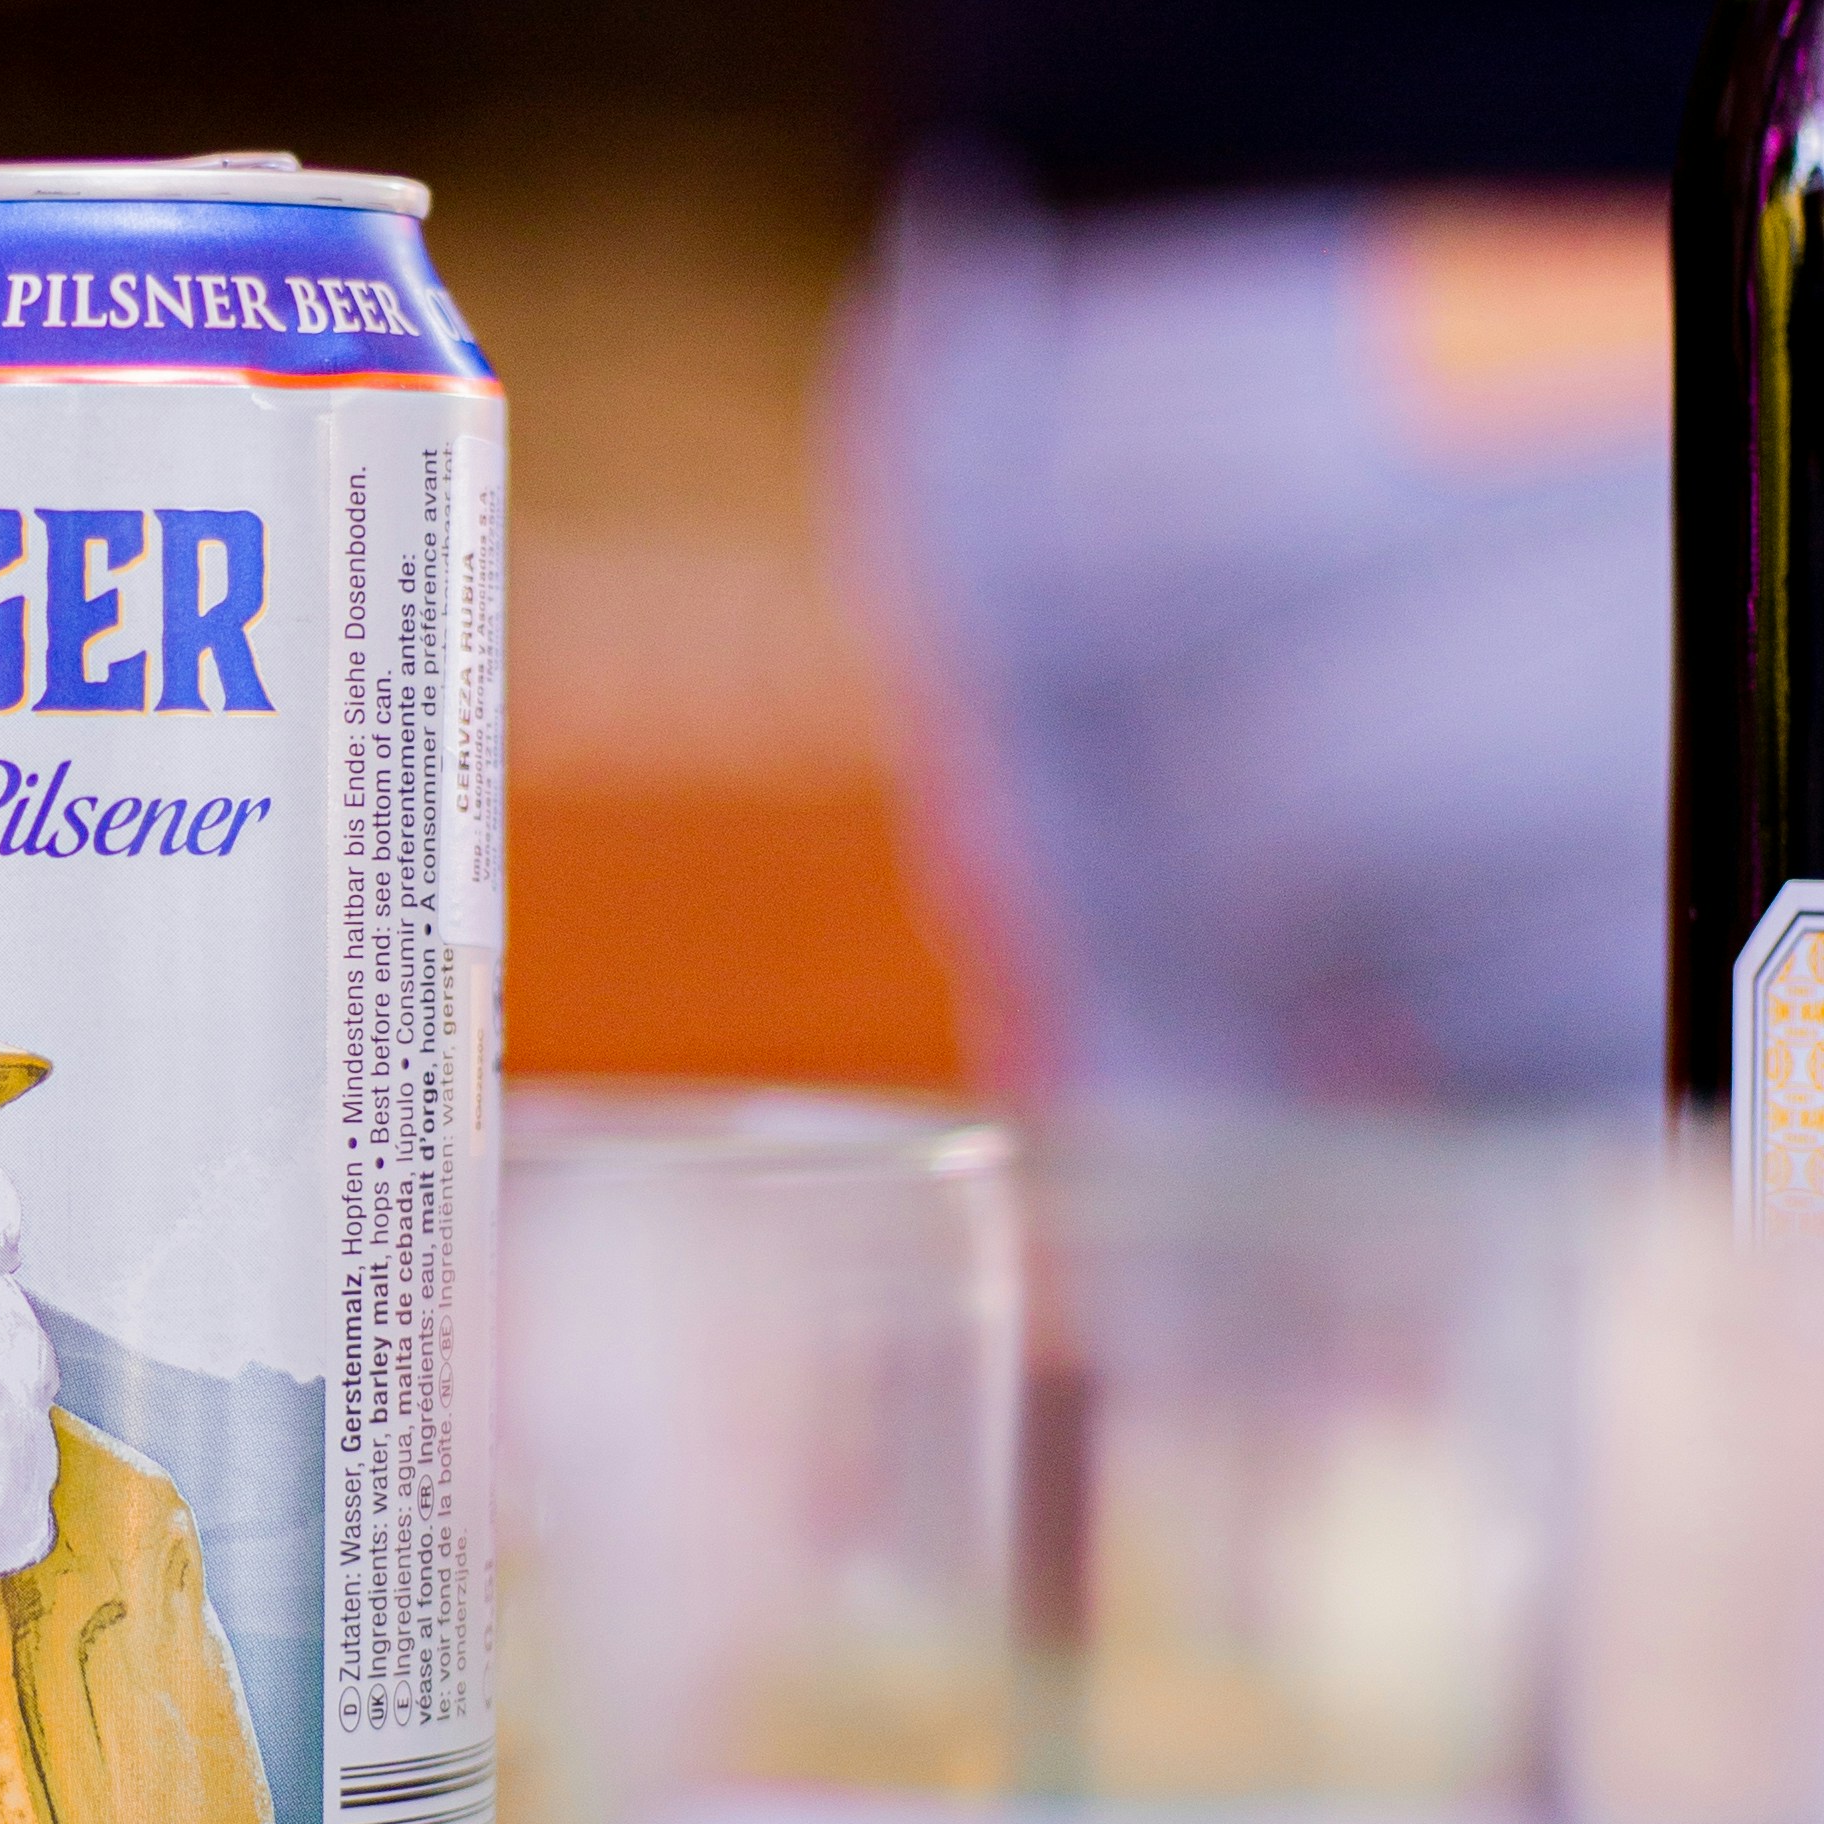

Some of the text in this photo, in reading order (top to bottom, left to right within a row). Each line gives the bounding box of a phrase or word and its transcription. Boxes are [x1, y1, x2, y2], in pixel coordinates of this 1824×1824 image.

[1, 272, 288, 334] PILSNER
[283, 277, 421, 338] BEER
[421, 448, 437, 523] avant
[344, 466, 365, 640] Dosenboden.
[398, 553, 416, 594] de:
[398, 603, 416, 677] antes
[421, 532, 441, 676] préférence
[344, 650, 365, 726] Siehe
[377, 669, 391, 725] can.
[421, 685, 437, 717] de
[456, 551, 474, 814] CERVEZA RUBIA
[343, 734, 364, 808] Ende:
[372, 733, 391, 760] of
[343, 818, 364, 857] bis
[372, 769, 391, 861] bottom
[397, 686, 419, 909] preferentemente
[424, 725, 436, 885] consommer
[343, 866, 364, 960] haltbar
[377, 871, 391, 918] see
[420, 893, 436, 912] A
[371, 926, 390, 983] end:
[396, 917, 414, 1045] Consumir
[441, 942, 457, 1037] gerste
[371, 993, 390, 1076] before
[420, 948, 436, 1054] houblon
[342, 969, 363, 1124] Mindestens
[371, 1085, 390, 1145] Best
[394, 1082, 418, 1163] lúpulo
[342, 1161, 368, 1256] Hopfen
[370, 1181, 394, 1245] hops
[395, 1171, 417, 1283] cebada,
[419, 1170, 435, 1235] malt
[370, 1254, 394, 1326] malt,
[395, 1292, 413, 1326] de
[423, 1243, 438, 1300] eau,
[341, 1265, 367, 1453] Gerstenmalz,
[370, 1336, 393, 1424] barley
[395, 1336, 413, 1416] malta
[418, 1309, 438, 1465] Ingrédients:
[369, 1432, 393, 1515] water,
[399, 1424, 416, 1497] agua,
[341, 1461, 367, 1566] Wasser,
[369, 1523, 392, 1679] Ingredients:
[394, 1505, 416, 1677] Ingredientes:
[417, 1525, 433, 1607] fondo.
[340, 1572, 361, 1682] Zutaten:
[417, 1617, 433, 1640] al
[415, 1648, 433, 1726] véase
